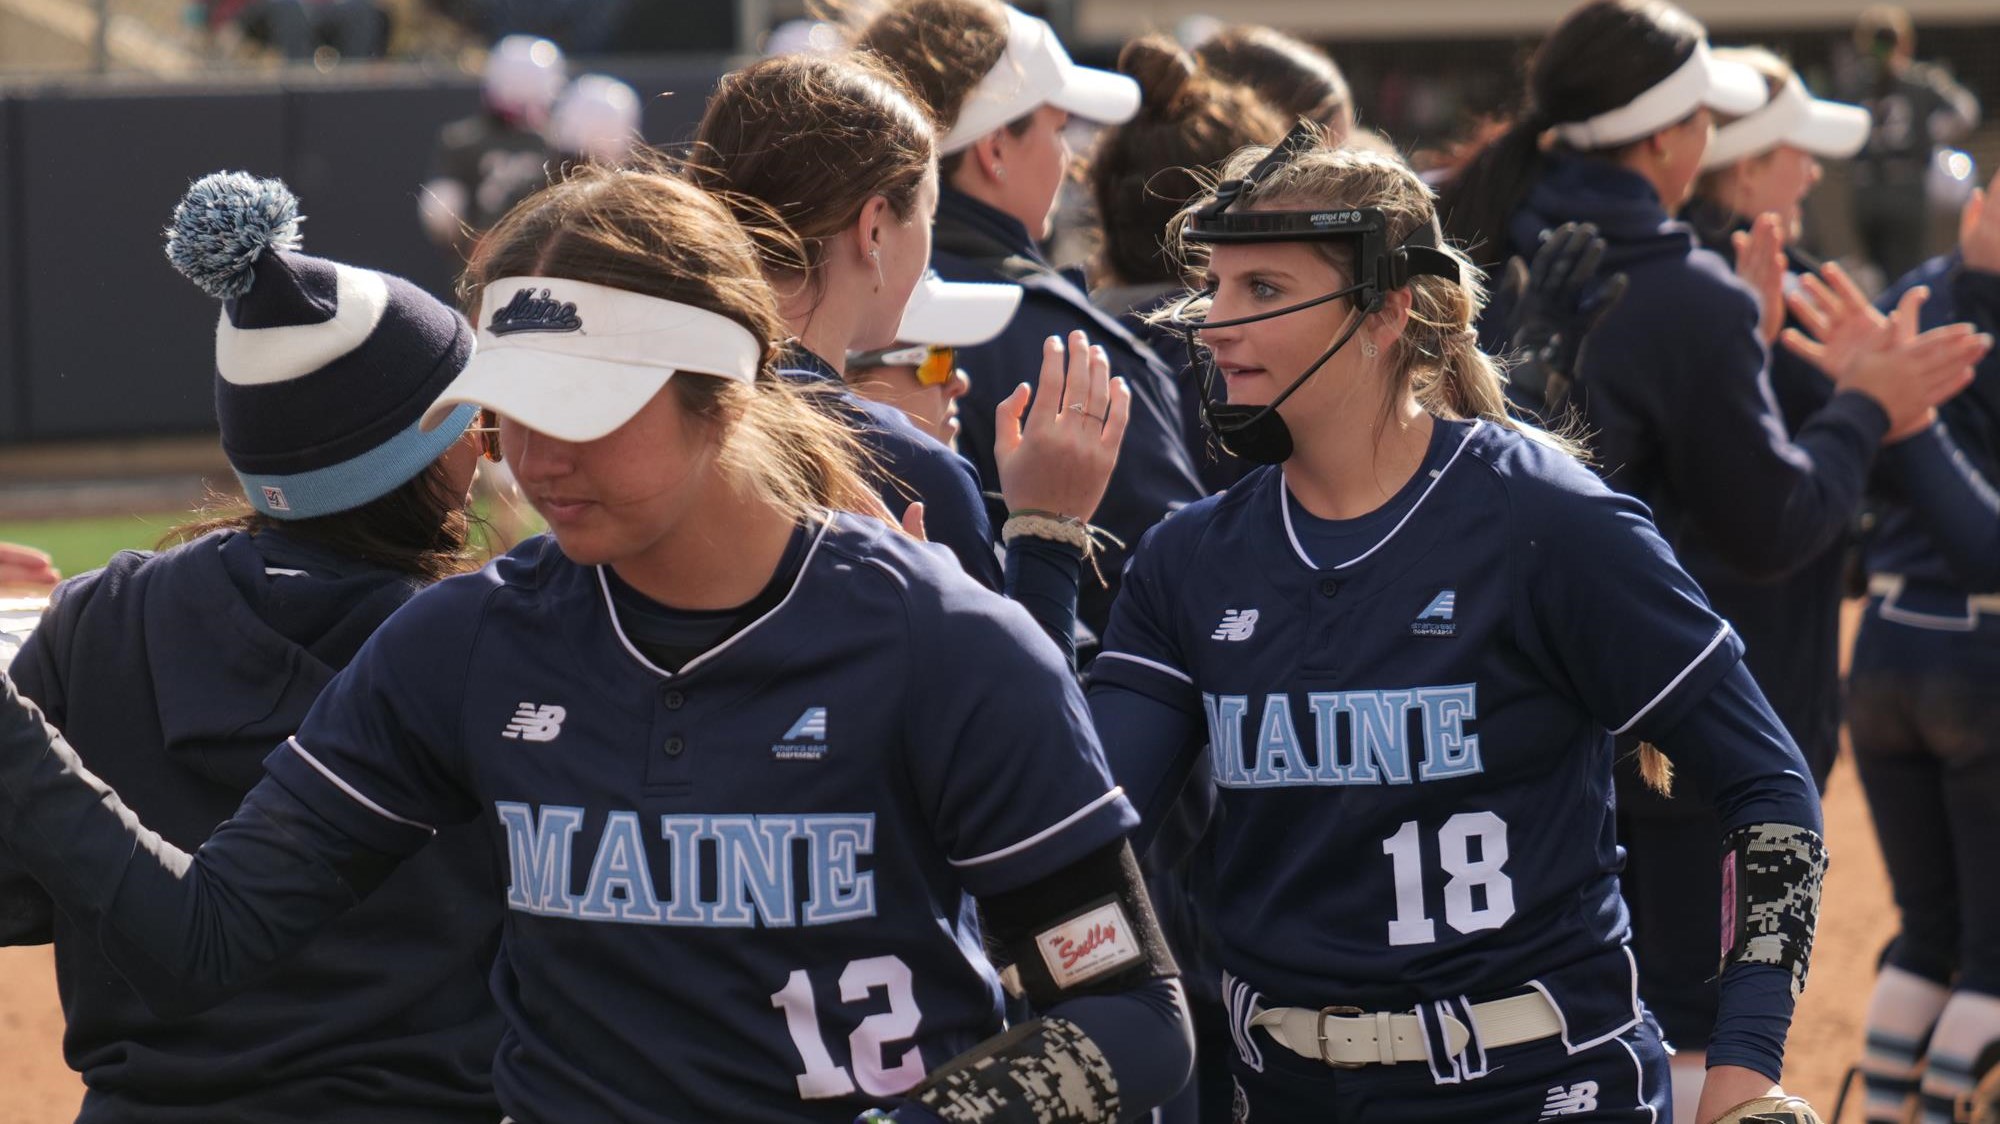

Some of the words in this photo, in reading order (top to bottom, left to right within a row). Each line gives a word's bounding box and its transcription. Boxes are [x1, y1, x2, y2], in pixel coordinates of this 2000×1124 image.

[486, 288, 583, 337] Maine
[1211, 609, 1259, 641] NB
[502, 702, 566, 742] NB
[1203, 682, 1484, 788] MAINE
[495, 801, 877, 928] MAINE
[1383, 811, 1516, 946] 18
[1059, 923, 1115, 969] Sully
[770, 955, 927, 1100] 12
